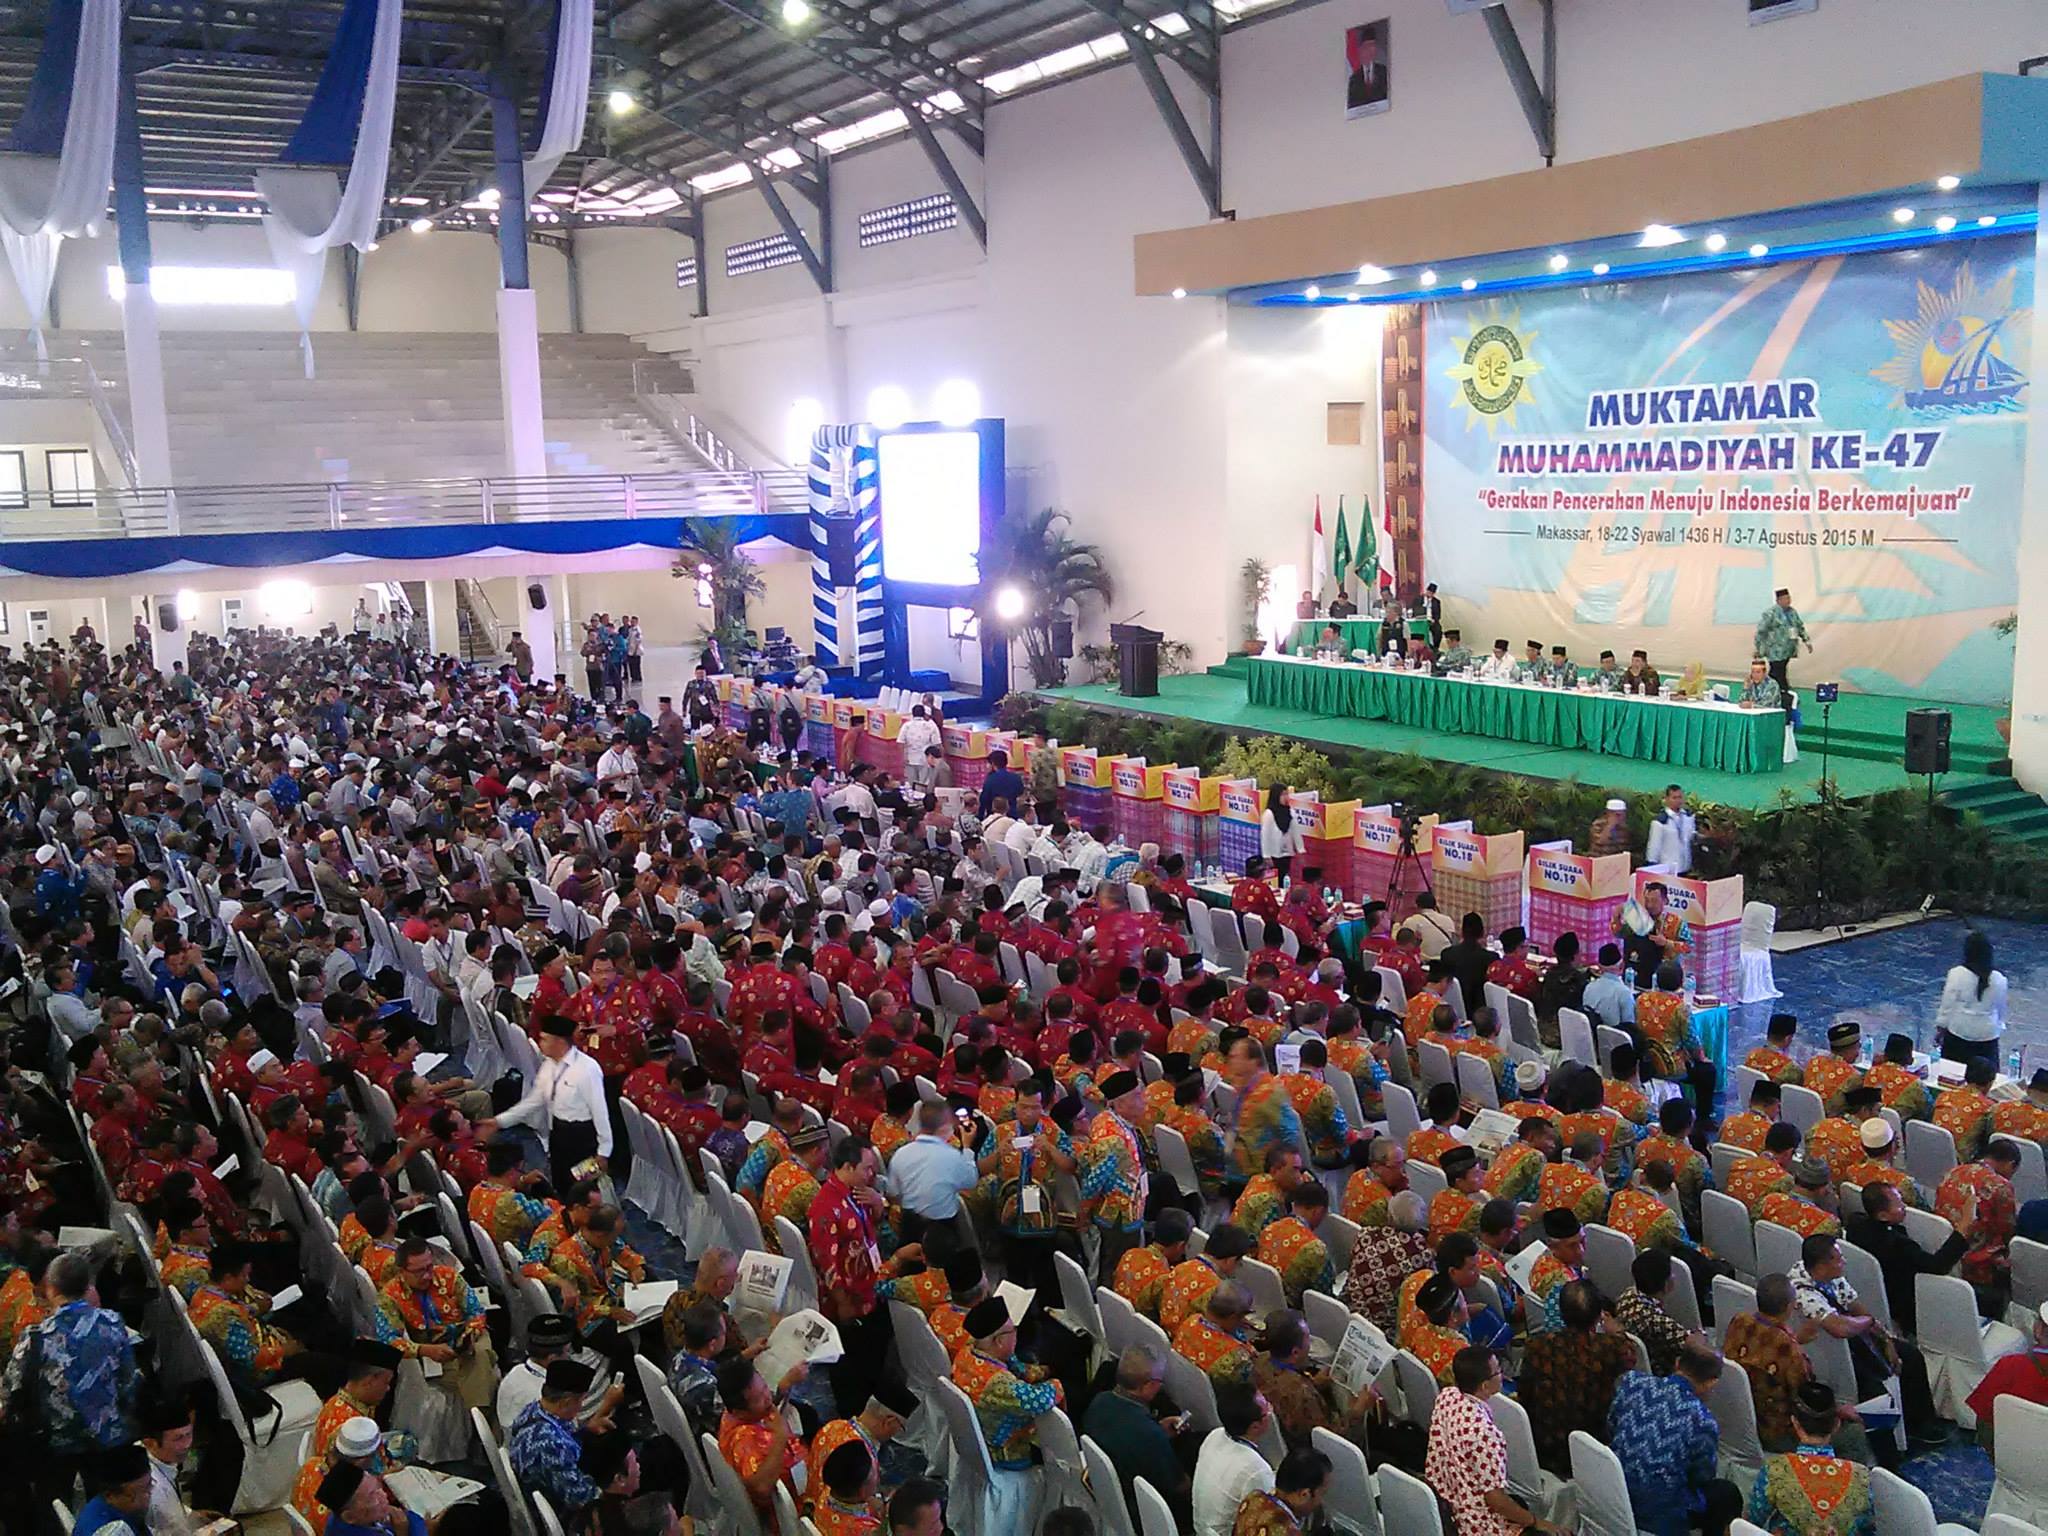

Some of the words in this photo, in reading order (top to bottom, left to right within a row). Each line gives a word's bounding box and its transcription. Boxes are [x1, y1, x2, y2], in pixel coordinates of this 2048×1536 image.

[1589, 382, 1816, 427] MUKTAMAR
[1497, 436, 1796, 474] MUHAMMADIYAH
[1810, 431, 1942, 470] KE-47
[1552, 489, 1645, 511] Pencerahan
[1650, 488, 1714, 516] Menuju
[1719, 487, 1811, 512] Indonesia
[1536, 524, 1594, 542] Makassar,
[1597, 526, 1629, 542] 18-22
[1630, 527, 1676, 546] Syawal
[1679, 528, 1710, 544] 1436
[1712, 528, 1724, 544] H
[1734, 527, 1755, 544] 3-7
[1758, 528, 1818, 548] Agustus
[1821, 528, 1858, 546] 2015
[1861, 529, 1875, 546] M
[1228, 801, 1250, 813] NO.15
[1297, 816, 1315, 827] O.16
[1365, 830, 1392, 843] NO.17
[1444, 847, 1473, 862] NO.18
[1544, 869, 1577, 885] NO.19
[1668, 887, 1697, 899] SUARA
